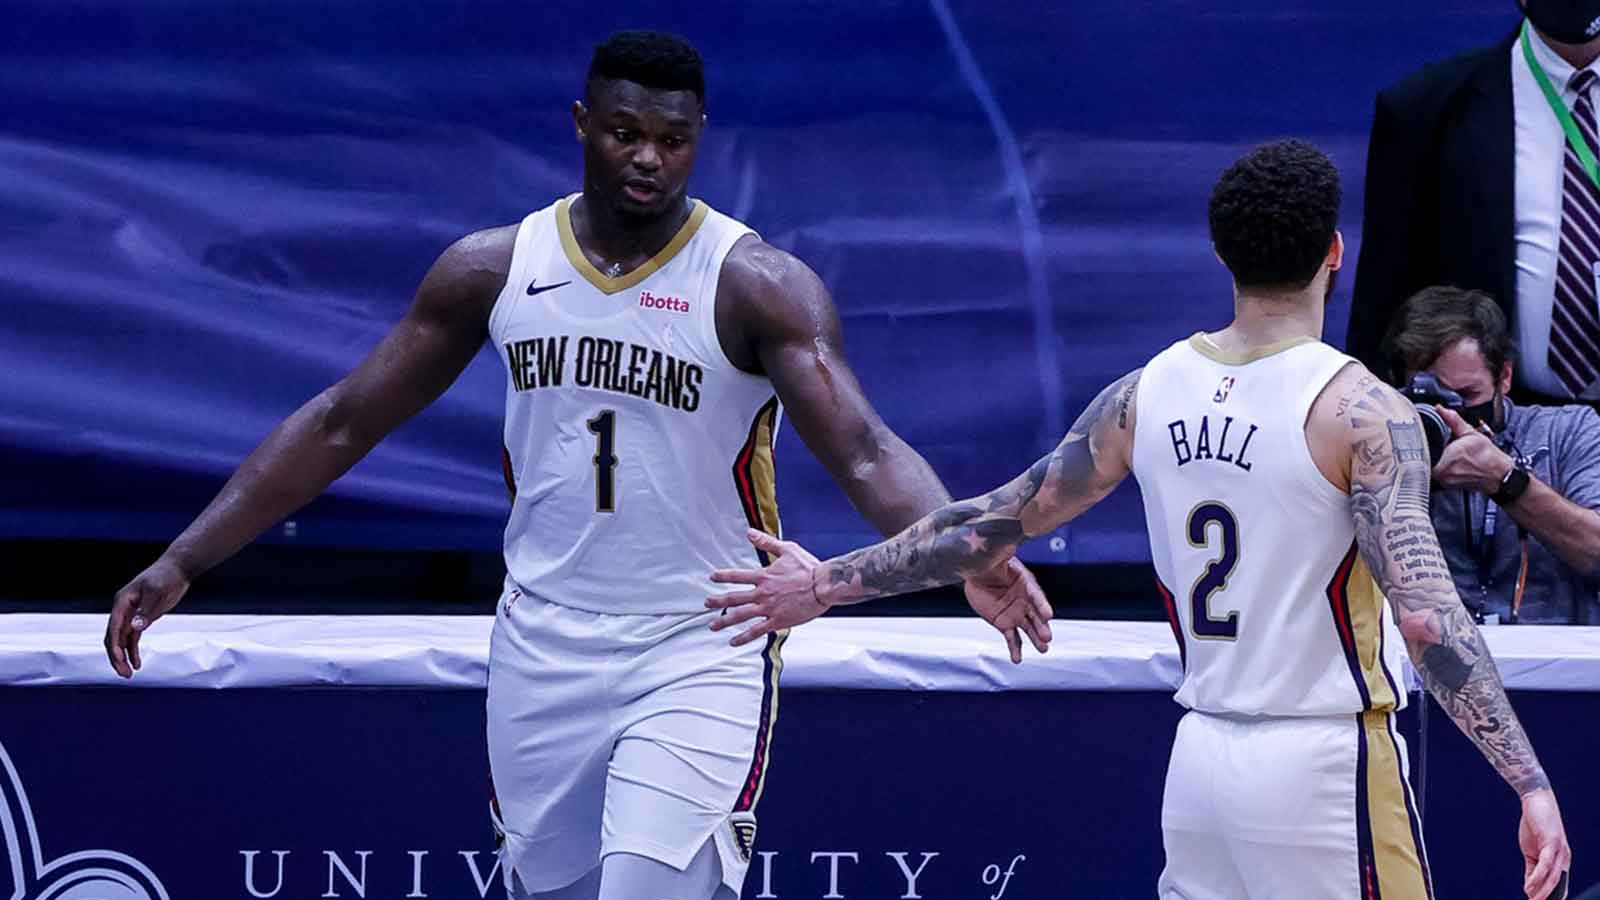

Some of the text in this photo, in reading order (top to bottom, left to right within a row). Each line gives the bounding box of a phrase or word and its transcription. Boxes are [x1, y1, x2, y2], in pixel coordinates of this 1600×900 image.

[637, 291, 690, 313] ibotta
[505, 335, 704, 413] NEW ORLEANS
[586, 409, 617, 514] 1
[1167, 415, 1259, 473] BALL
[1185, 500, 1241, 642] 2
[1473, 717, 1500, 740] 2
[240, 851, 1026, 900] UNIVITY of
